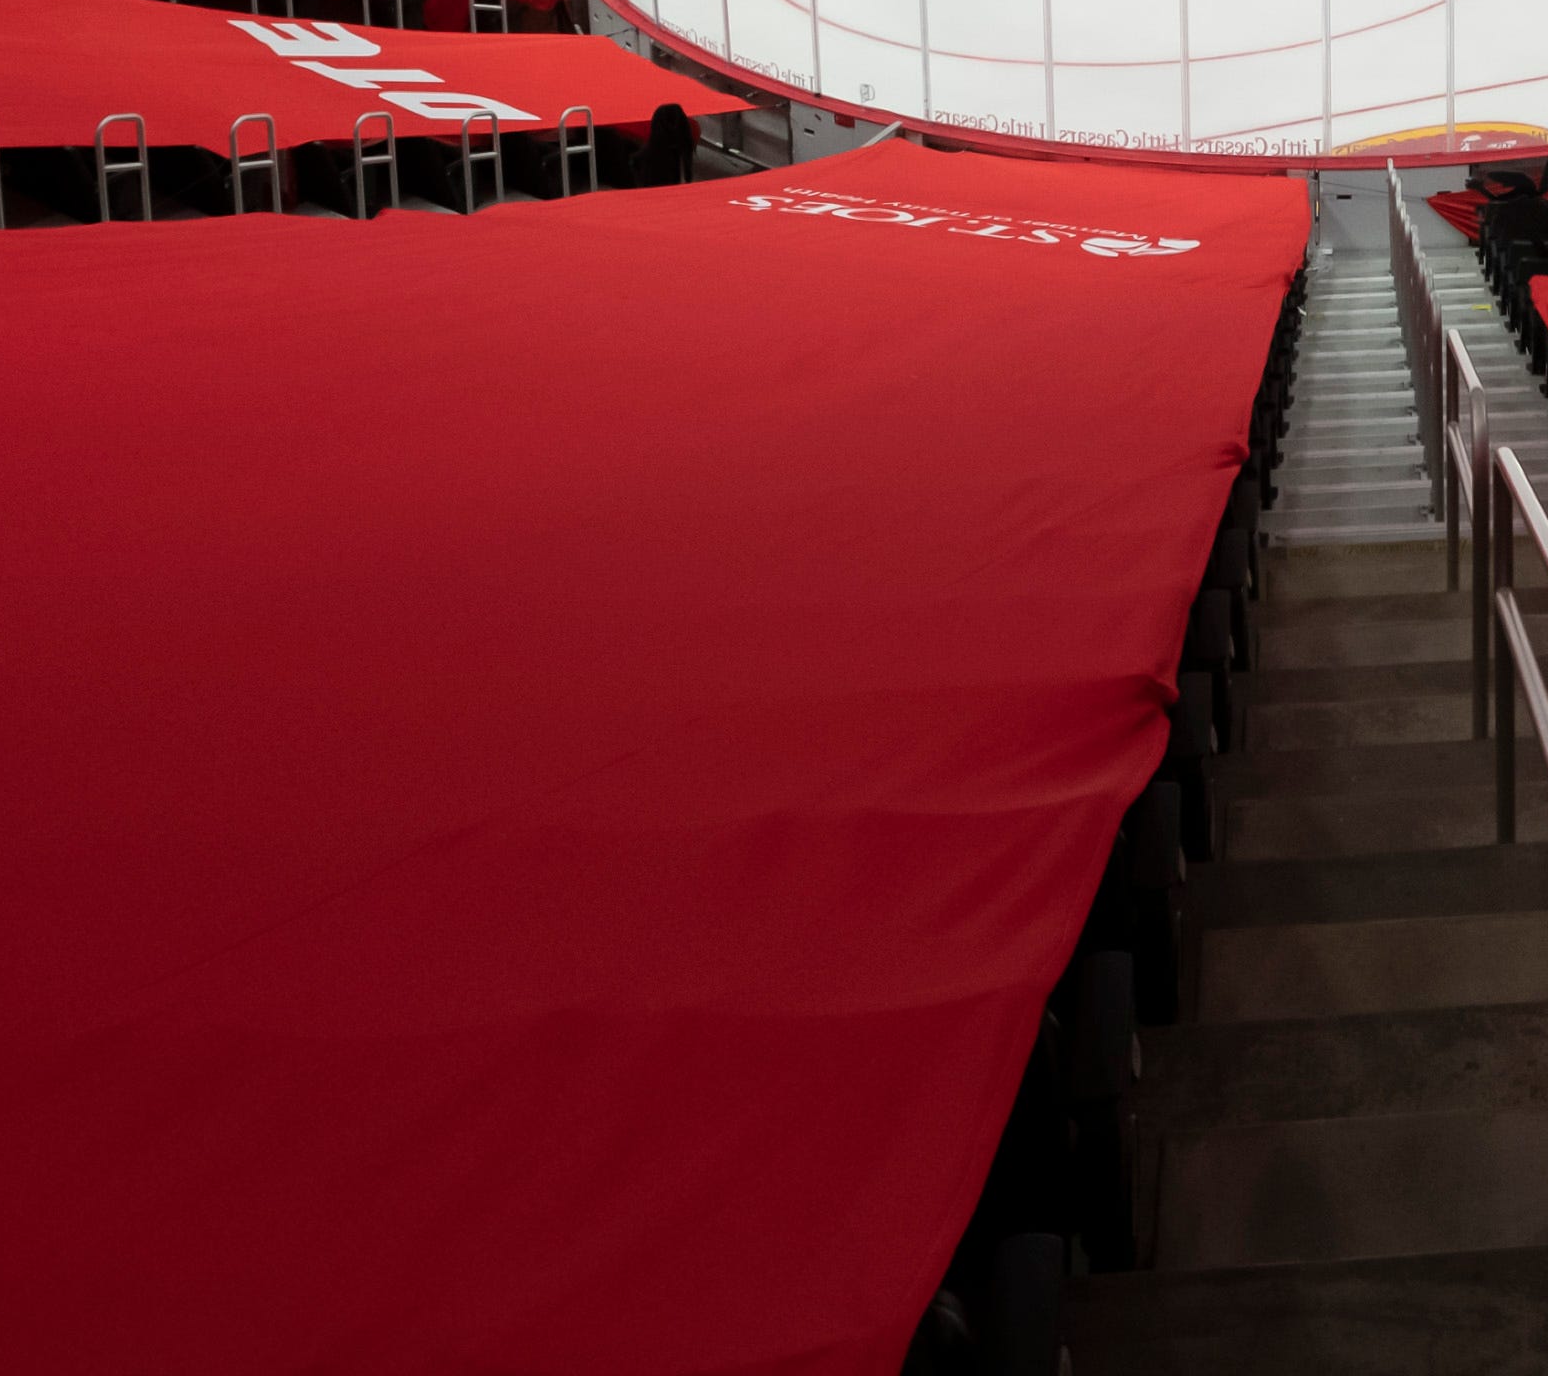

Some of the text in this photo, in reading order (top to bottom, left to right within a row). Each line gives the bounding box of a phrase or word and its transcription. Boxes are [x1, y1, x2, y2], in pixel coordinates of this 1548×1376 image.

[227, 20, 542, 120] DTE
[728, 195, 1078, 245] ST. JOE'S
